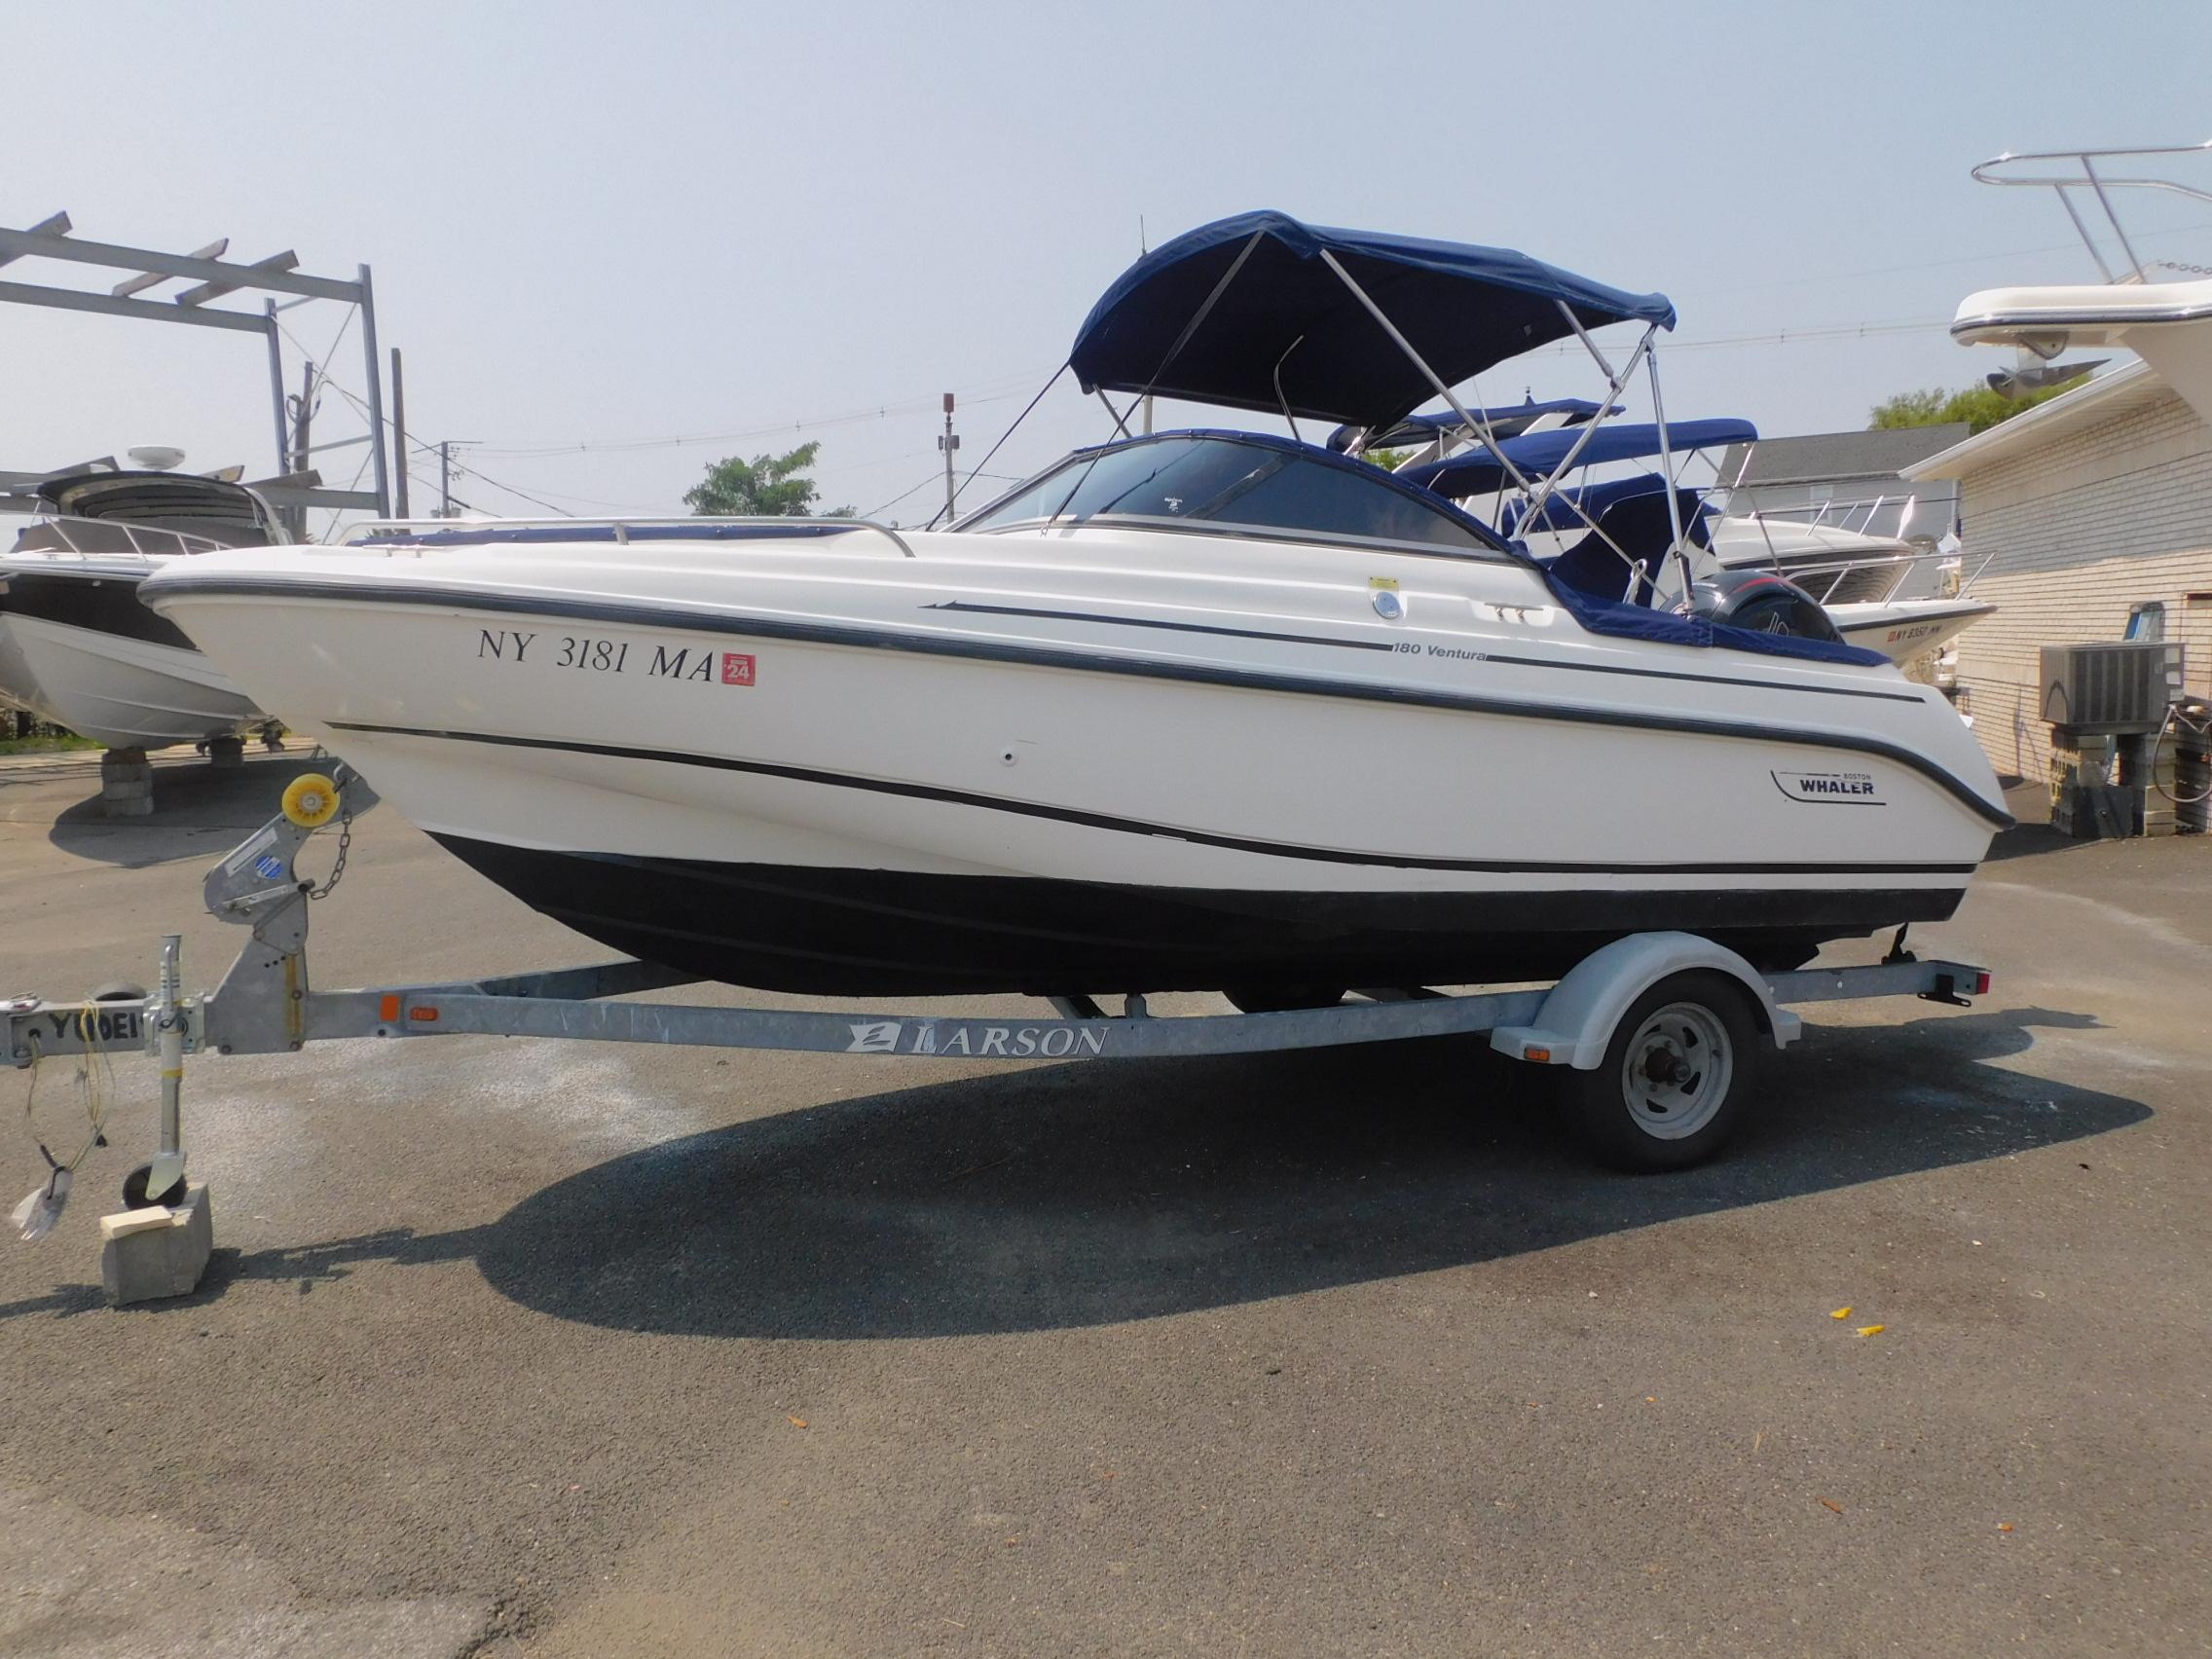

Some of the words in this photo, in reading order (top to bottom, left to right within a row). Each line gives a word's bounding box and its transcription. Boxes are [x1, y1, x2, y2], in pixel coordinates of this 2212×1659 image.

[477, 629, 536, 663] NY
[557, 637, 629, 673] 3181
[646, 645, 714, 682] MA
[1392, 642, 1421, 655] 180
[1427, 645, 1487, 662] Ventura
[1799, 779, 1874, 794] WHALER
[911, 1025, 1110, 1056] LARSON
